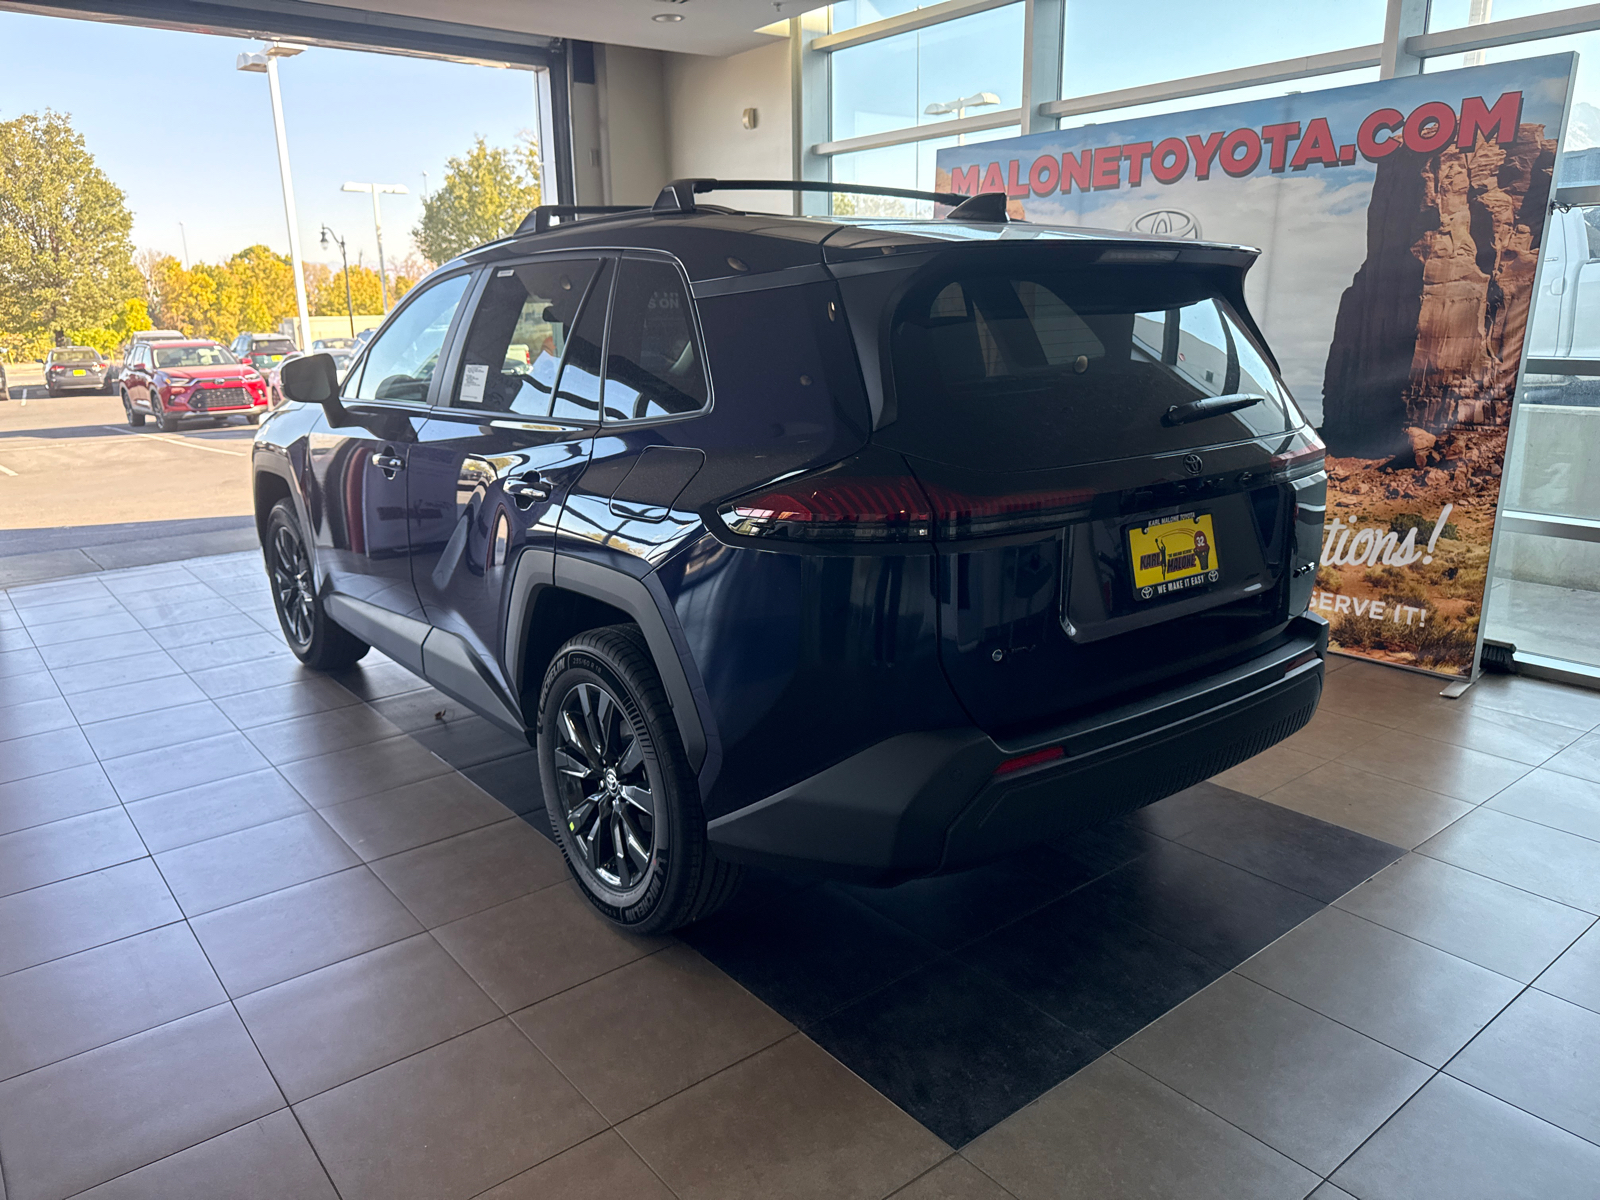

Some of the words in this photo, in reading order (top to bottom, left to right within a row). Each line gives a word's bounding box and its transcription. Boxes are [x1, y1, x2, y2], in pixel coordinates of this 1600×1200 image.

[951, 90, 1524, 200] MALONETOYOTA.COM
[1161, 514, 1180, 524] MALONE
[1196, 535, 1205, 546] 32
[1320, 503, 1453, 567] tions!
[1140, 552, 1162, 571] KARL
[1167, 553, 1197, 574] MALONE
[1157, 584, 1167, 594] WE
[1168, 580, 1183, 591] MAKE
[1184, 578, 1191, 587] IT
[1191, 574, 1205, 585] EASY
[1393, 604, 1427, 628] IT!
[540, 657, 566, 711] MICHELIN
[625, 873, 662, 922] MICHELIN
